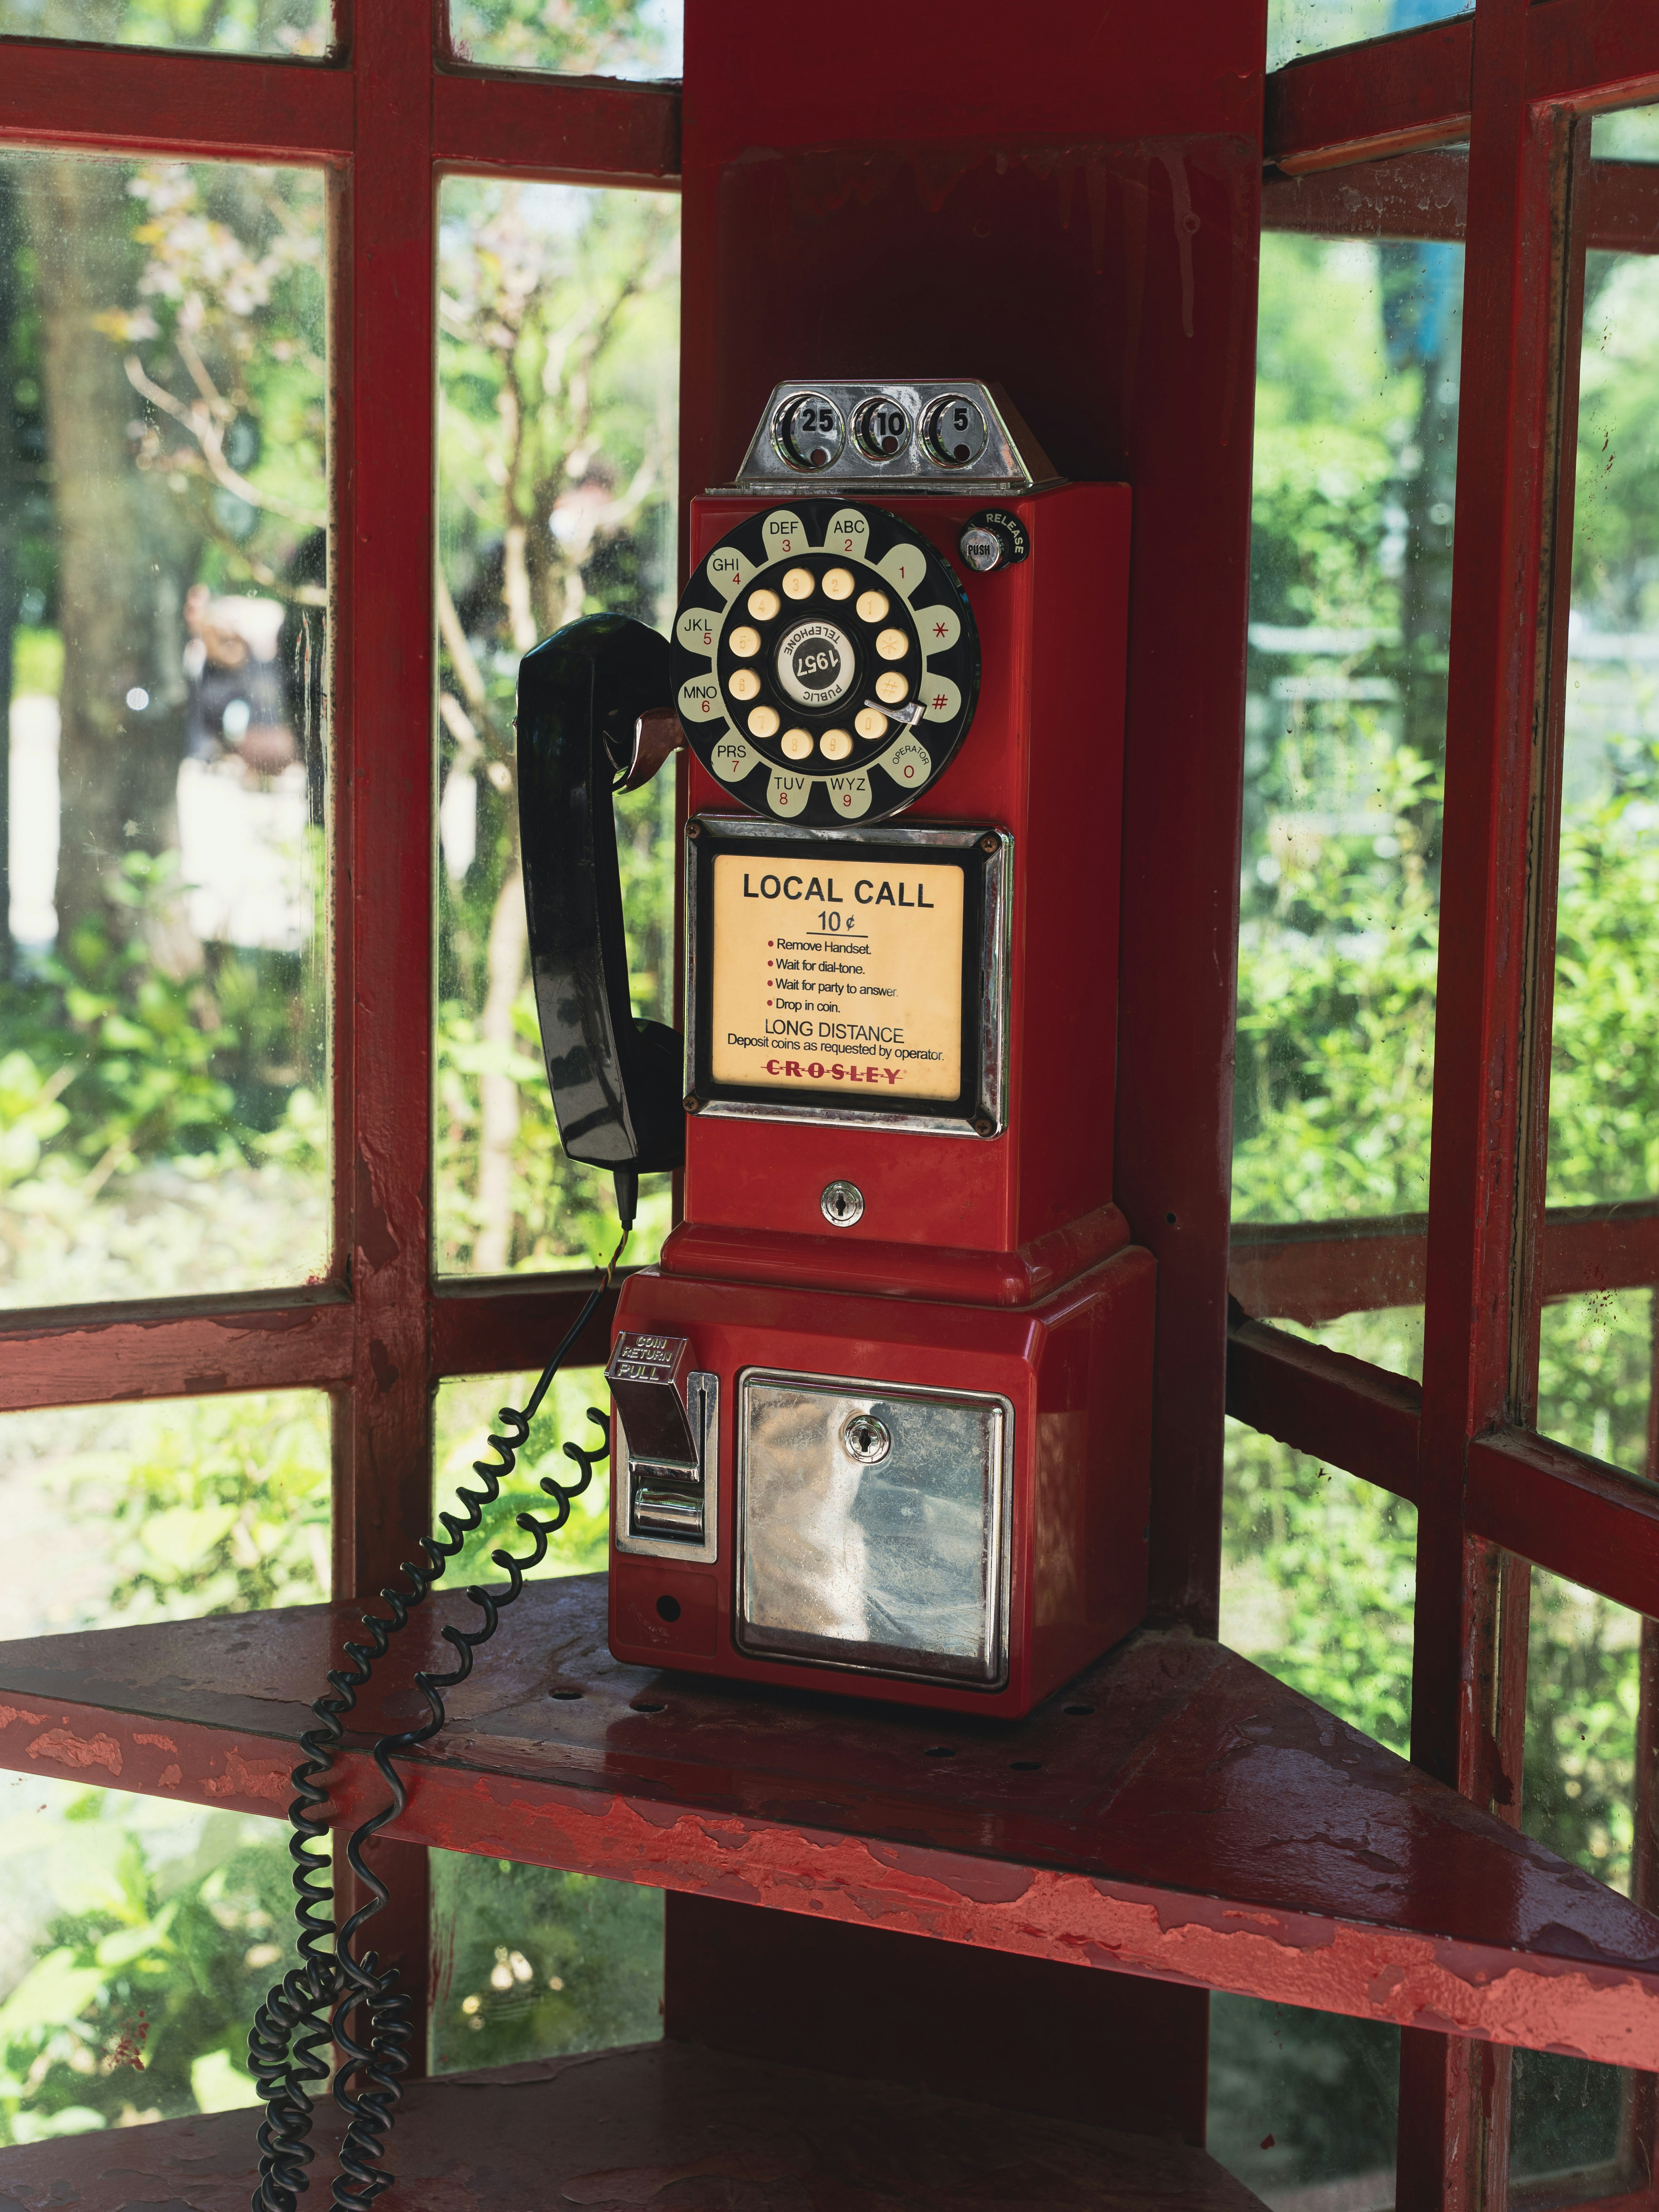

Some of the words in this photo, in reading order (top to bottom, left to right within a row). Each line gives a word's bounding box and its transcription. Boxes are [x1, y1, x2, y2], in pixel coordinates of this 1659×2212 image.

[802, 408, 833, 432] 25
[878, 412, 904, 436] 10
[954, 408, 968, 431] 5
[770, 521, 799, 535] DEF
[834, 520, 865, 533] ABC
[986, 514, 1024, 554] RELEASE
[782, 540, 791, 552] 3
[845, 540, 853, 551] 2
[968, 544, 990, 555] PUSH
[713, 559, 739, 571] GHI
[899, 566, 904, 578] 1
[733, 573, 741, 585] 4
[793, 578, 799, 591] 3
[832, 579, 838, 591] 2
[757, 600, 765, 613] 4
[867, 601, 872, 614] 1
[684, 619, 712, 631] JKL
[704, 633, 711, 645] 5
[739, 636, 746, 649] 5
[784, 626, 841, 655] TELEPHONE
[796, 650, 839, 677] 1957
[738, 678, 745, 692] 6
[684, 687, 717, 699] MNO
[803, 684, 842, 702] PUBLIC
[702, 701, 710, 713] 6
[757, 716, 764, 728] 7
[792, 738, 798, 752] 8
[830, 738, 836, 751] 9
[718, 746, 746, 758] PRS
[892, 746, 929, 766] OPERATOR
[732, 760, 740, 772] 7
[774, 777, 805, 790] TUV
[831, 778, 866, 791] WYZ
[779, 793, 788, 805] 8
[843, 795, 852, 807] 9
[744, 873, 843, 902] LOCAL
[854, 880, 934, 908] CALL
[818, 911, 841, 931] 10
[777, 939, 822, 952] Remove
[825, 942, 871, 955] Handset.
[776, 958, 800, 971] Wait
[802, 959, 816, 972] for
[818, 961, 865, 975] dial-tone.
[776, 978, 799, 991] Wait
[802, 980, 816, 992] for
[818, 983, 844, 996] party
[846, 984, 856, 994] to
[859, 986, 898, 997] answer.
[776, 998, 802, 1013] Drop
[805, 1000, 814, 1011] in
[816, 1001, 841, 1013] coin.
[766, 1019, 813, 1036] LONG
[819, 1022, 905, 1043] DISTANCE
[728, 1034, 769, 1048] Deposit
[772, 1039, 800, 1050] coins
[803, 1042, 817, 1051] as
[821, 1042, 876, 1056] requested
[879, 1045, 892, 1059] by
[894, 1048, 944, 1061] operator.
[636, 1336, 667, 1349] COIN
[622, 1347, 672, 1362] RETURN
[618, 1365, 659, 1380] PULL
